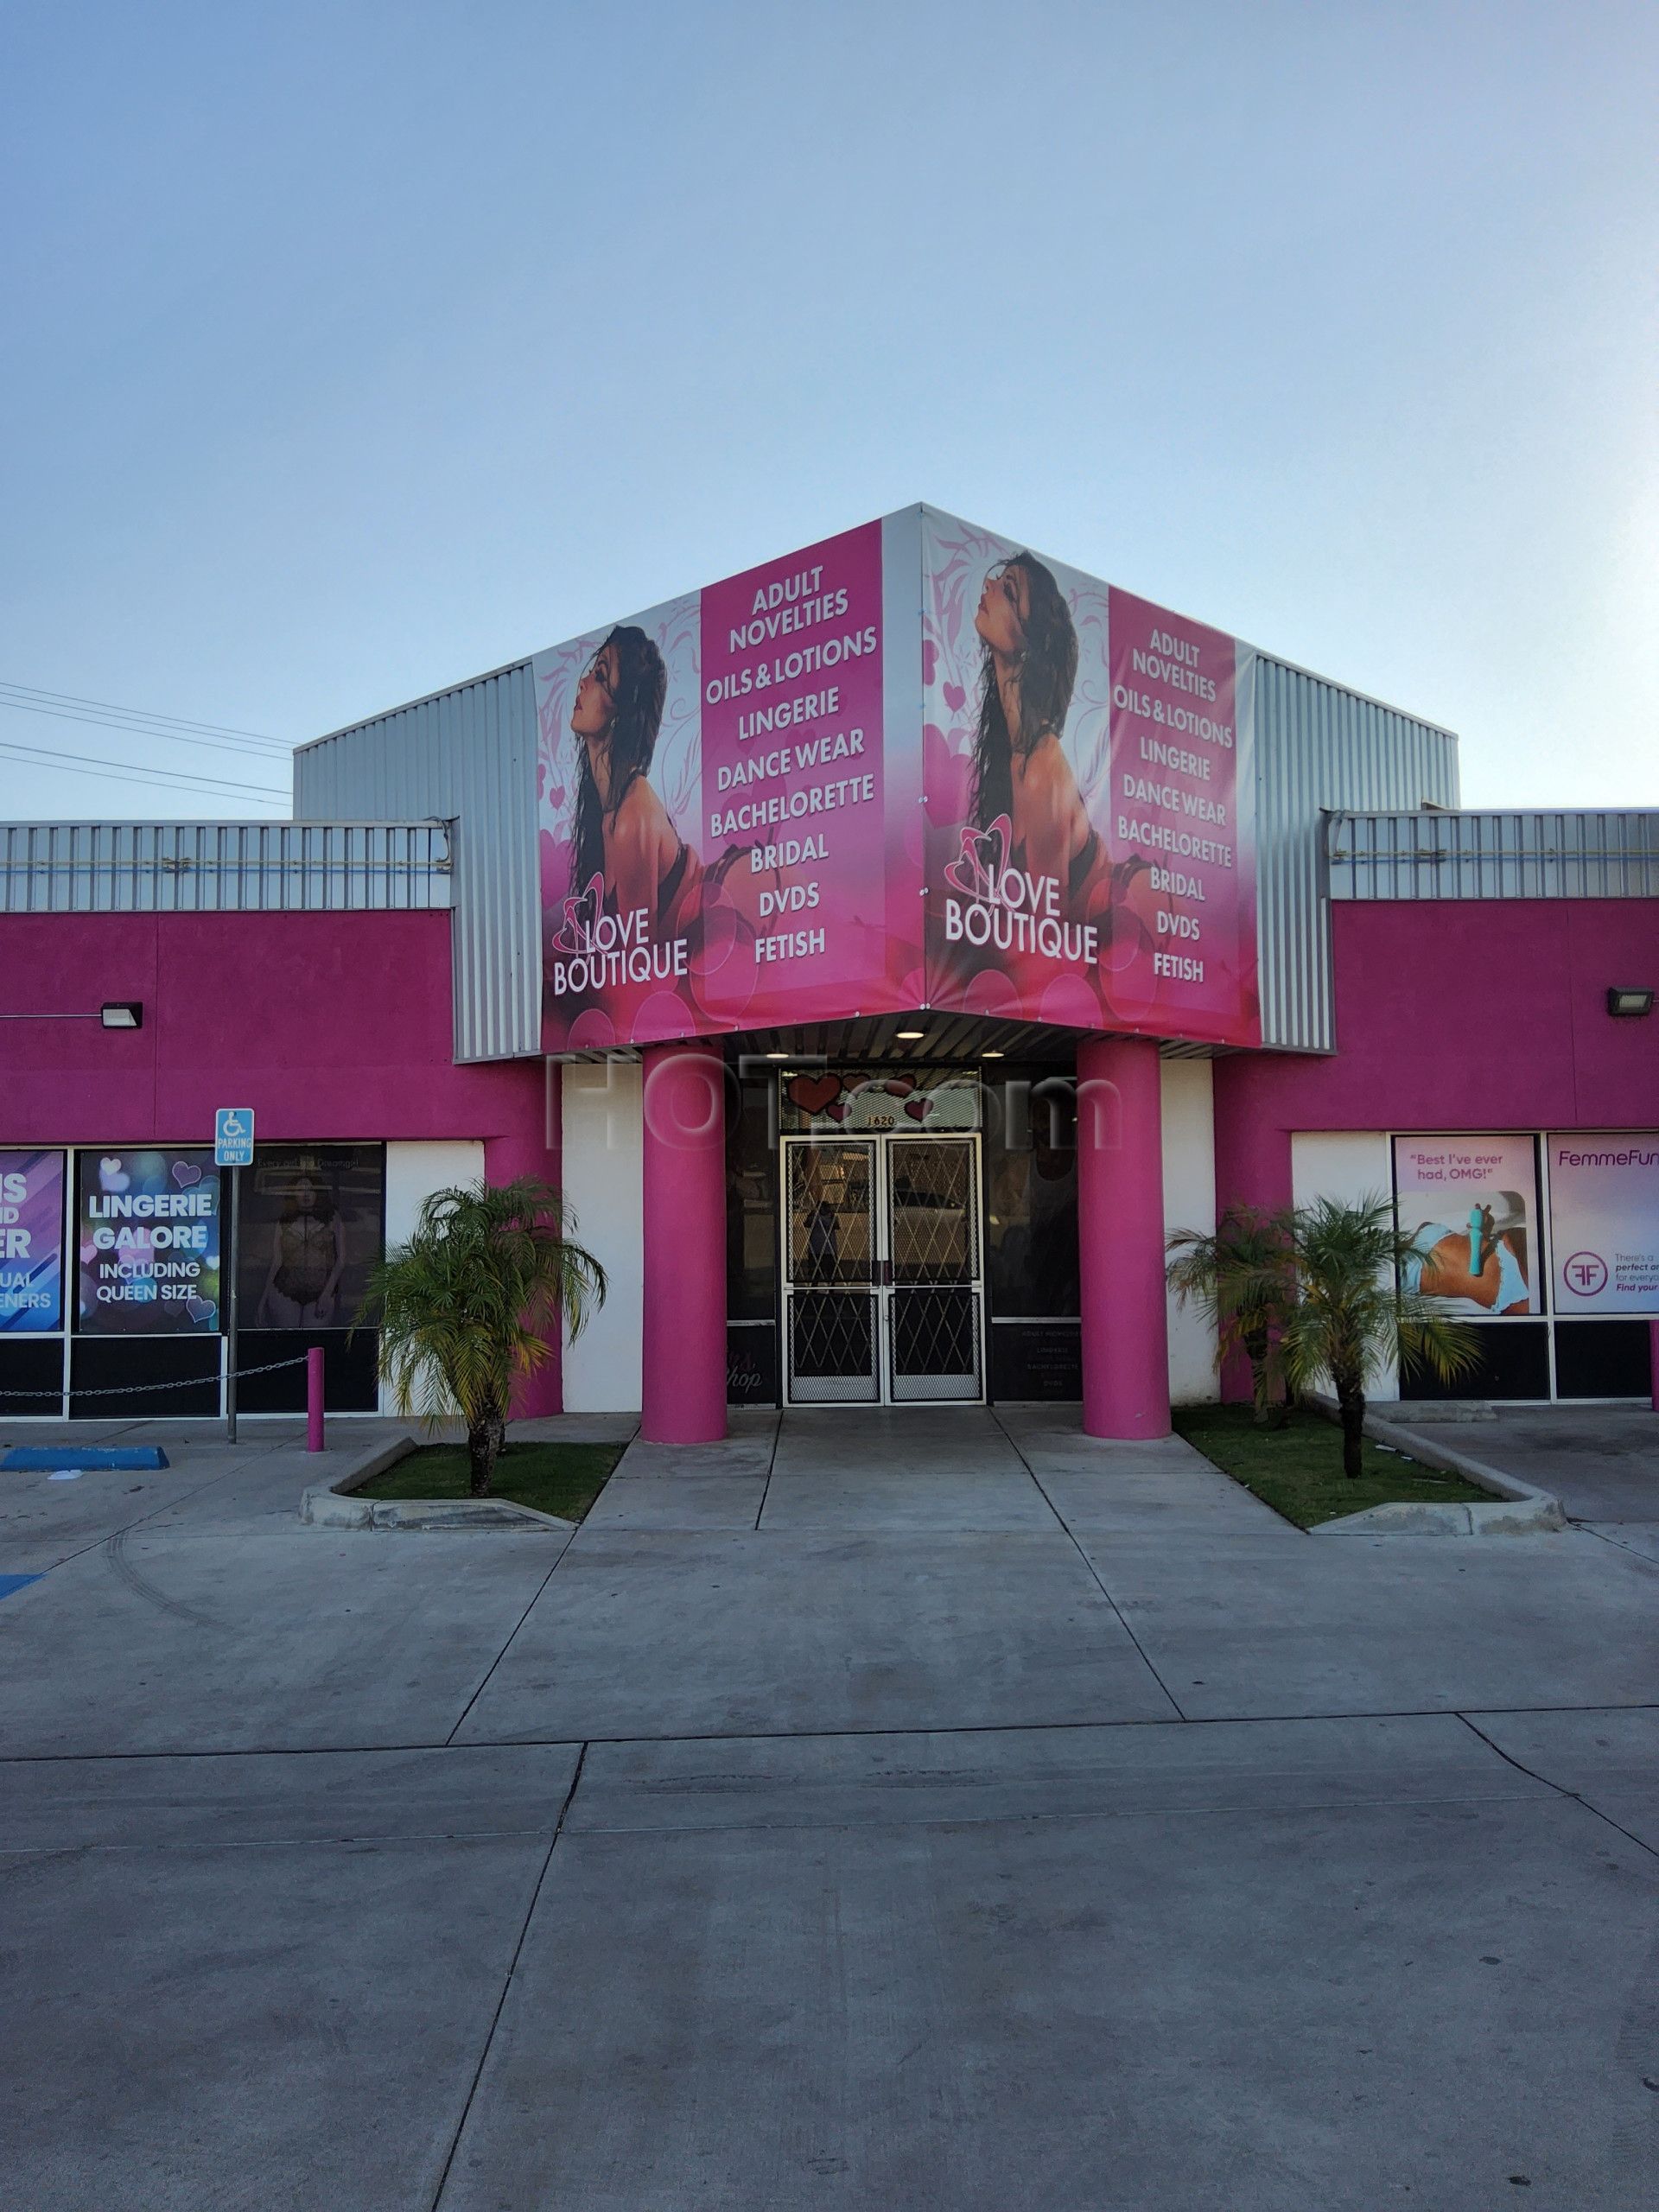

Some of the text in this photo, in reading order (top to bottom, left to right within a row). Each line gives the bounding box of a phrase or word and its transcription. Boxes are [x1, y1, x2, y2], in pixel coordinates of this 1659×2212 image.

[752, 565, 823, 615] ADULT
[729, 588, 849, 653] NOVELTIES
[1149, 629, 1199, 667] ADULT
[1133, 648, 1216, 702] NOVELTIES
[738, 686, 839, 741] LINGERIE
[718, 728, 864, 791] DANCE WEAR
[1141, 736, 1211, 780] LINGERIE
[711, 773, 874, 838] BACHELORETTE
[1124, 774, 1226, 826] DANCE WEAR
[751, 834, 829, 873] BRIDAL
[1118, 815, 1231, 868] BACHELORETTE
[760, 882, 820, 917] DVDS
[988, 864, 1060, 917] LOVE
[1150, 866, 1205, 902] BRIDAL
[586, 908, 649, 953] LOVE
[946, 899, 1098, 964] BOUTIQUE
[1157, 911, 1199, 940] DVDS
[755, 928, 825, 963] FETISH
[555, 939, 688, 995] BOUTIQUE
[1154, 952, 1204, 982] FETISH
[868, 1116, 894, 1125] 1620
[218, 1137, 251, 1148] PARKING
[224, 1150, 245, 1161] ONLY
[1448, 1154, 1471, 1165] I've
[1474, 1155, 1503, 1165] ever
[0, 1173, 27, 1204] S
[1418, 1169, 1446, 1181] had,
[0, 1206, 19, 1224] D
[89, 1193, 212, 1218] LINGERIE
[93, 1225, 207, 1249] GALORE
[99, 1262, 200, 1279] INCLUDING
[1616, 1263, 1648, 1273] perfect
[1616, 1274, 1627, 1282] for
[96, 1284, 197, 1303] QUEEN SIZE
[1638, 1285, 1658, 1294] your
[727, 1365, 762, 1393] hop
